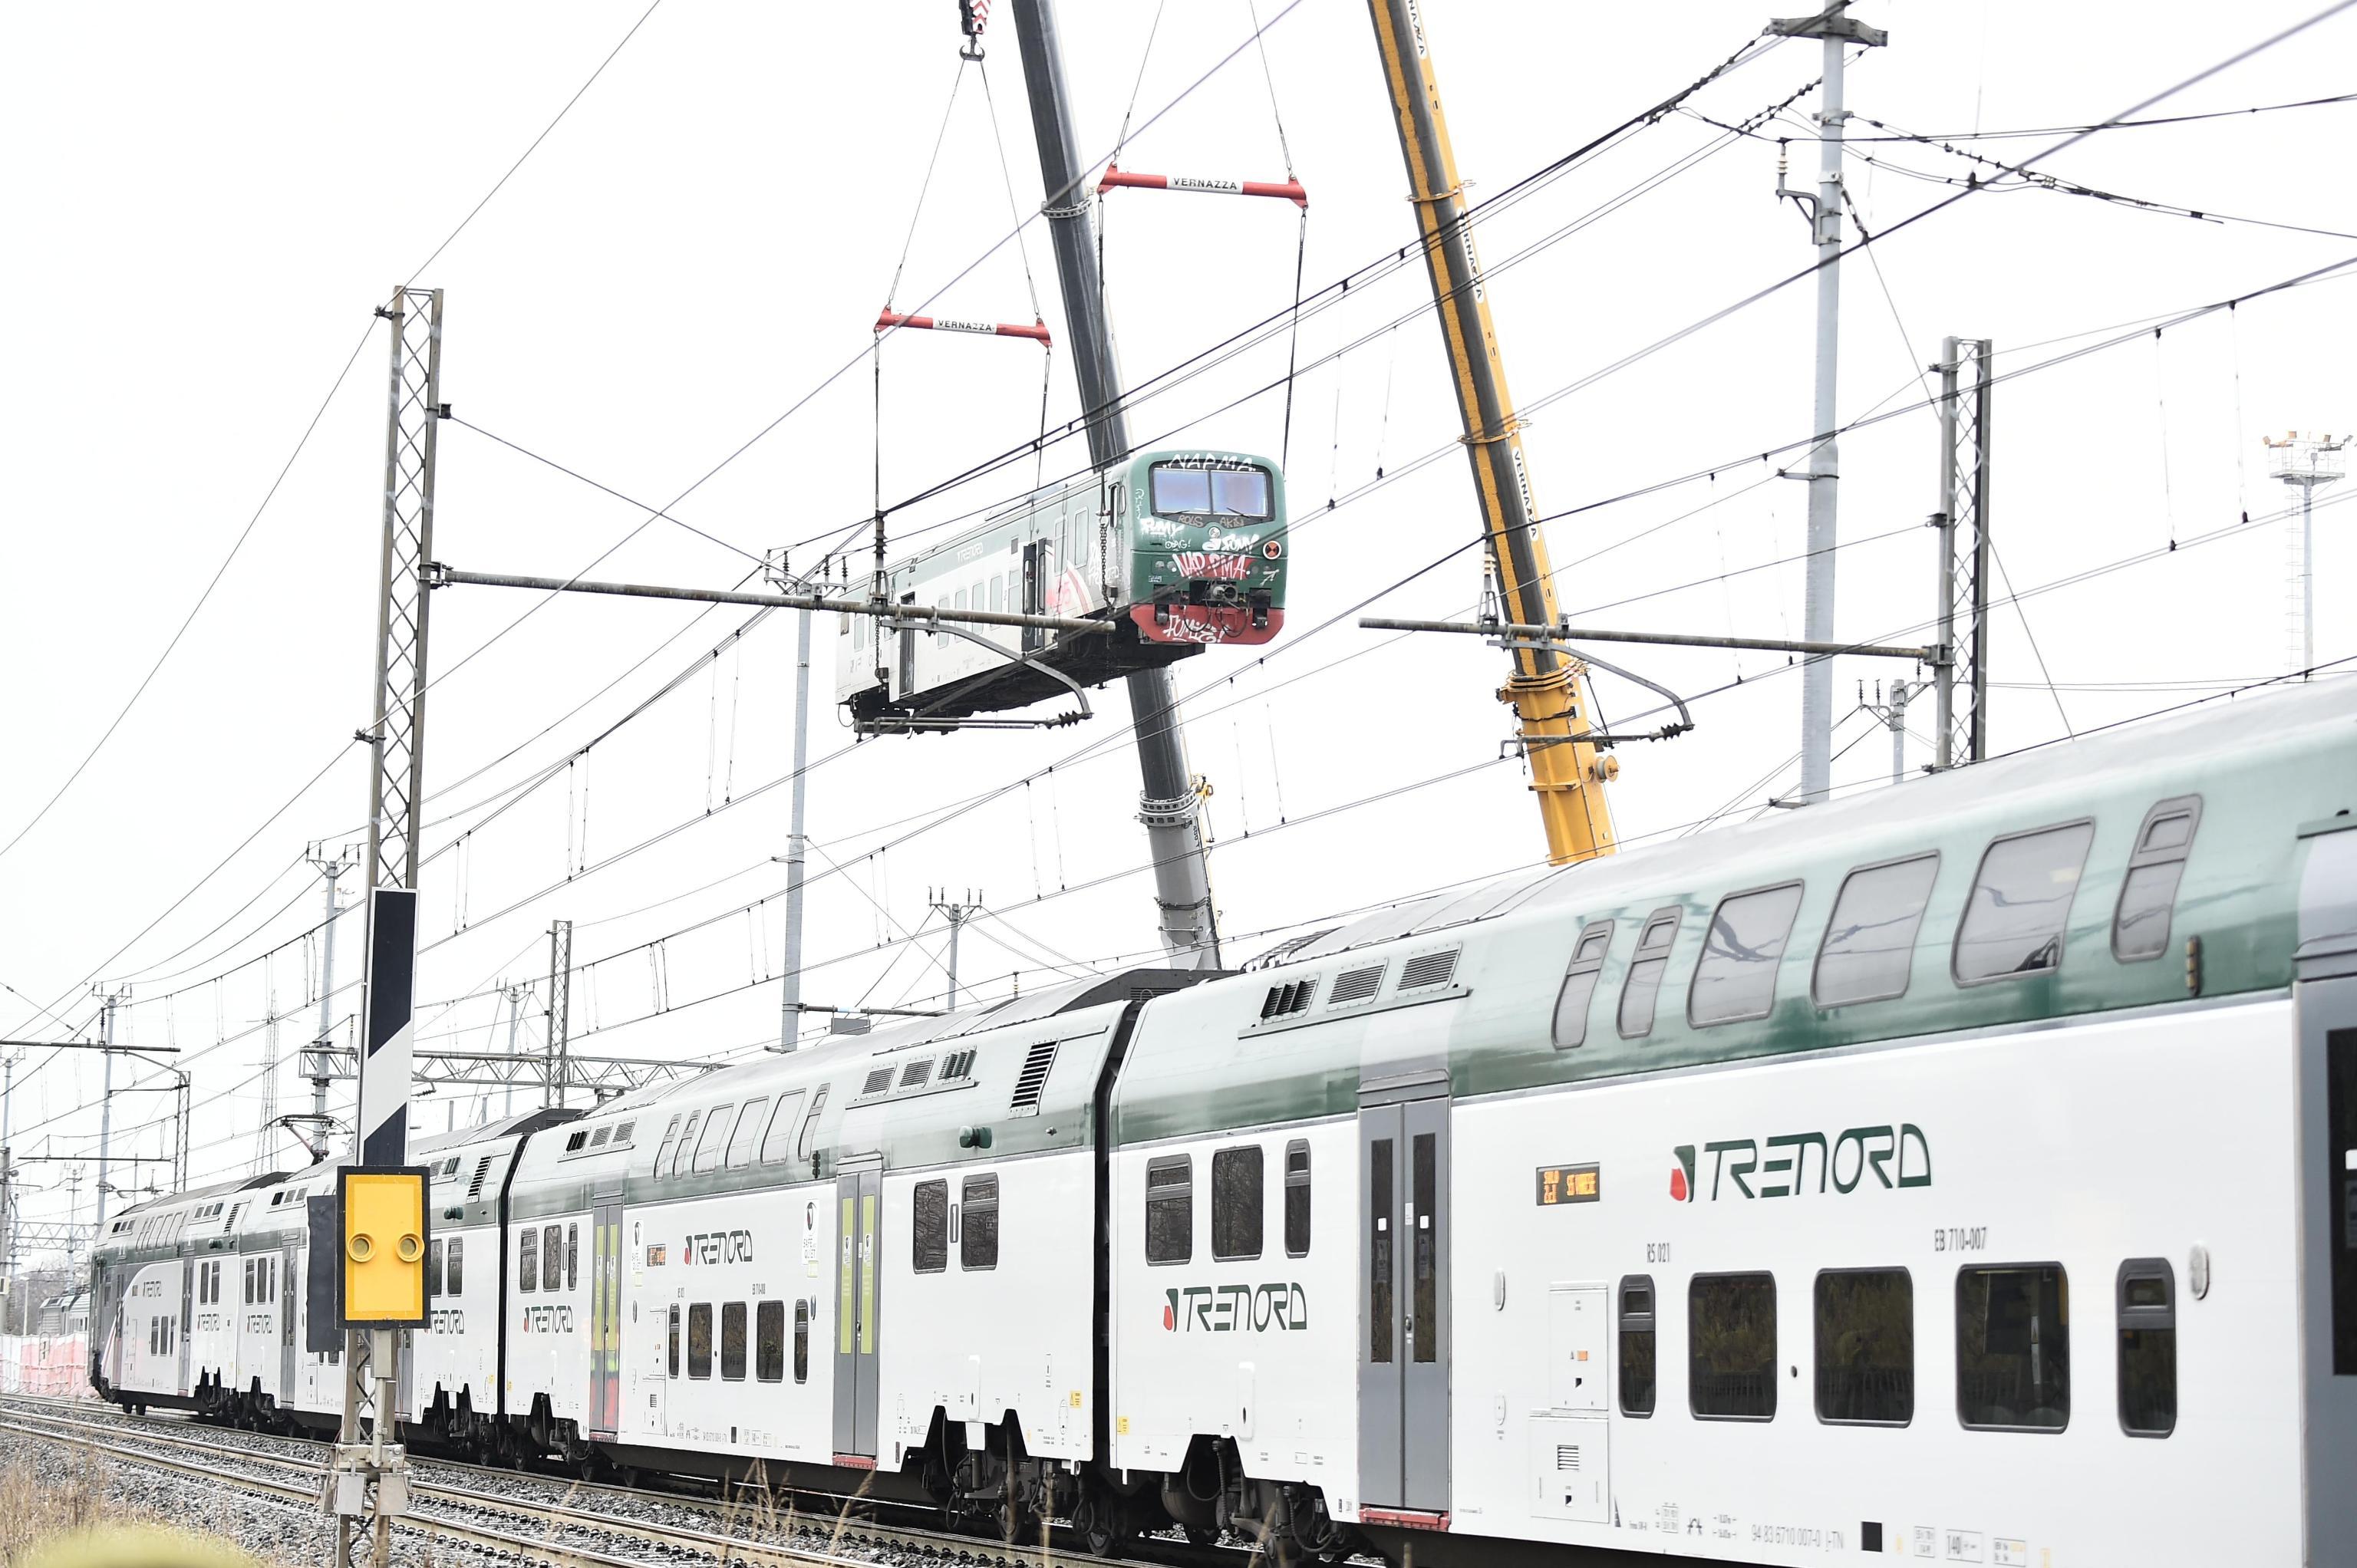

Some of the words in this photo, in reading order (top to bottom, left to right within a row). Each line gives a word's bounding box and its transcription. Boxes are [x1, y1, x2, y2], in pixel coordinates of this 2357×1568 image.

[1173, 177, 1238, 190] VERNAZZA
[938, 319, 993, 332] VERNAZZA
[1514, 450, 1538, 539] VERNAZZA
[1703, 1123, 1932, 1201] TRENORD
[694, 1229, 753, 1266] TRENORD
[1948, 1227, 1986, 1251] 710-007
[531, 1306, 573, 1333] TRENORD
[1182, 1282, 1307, 1332] TRENORD
